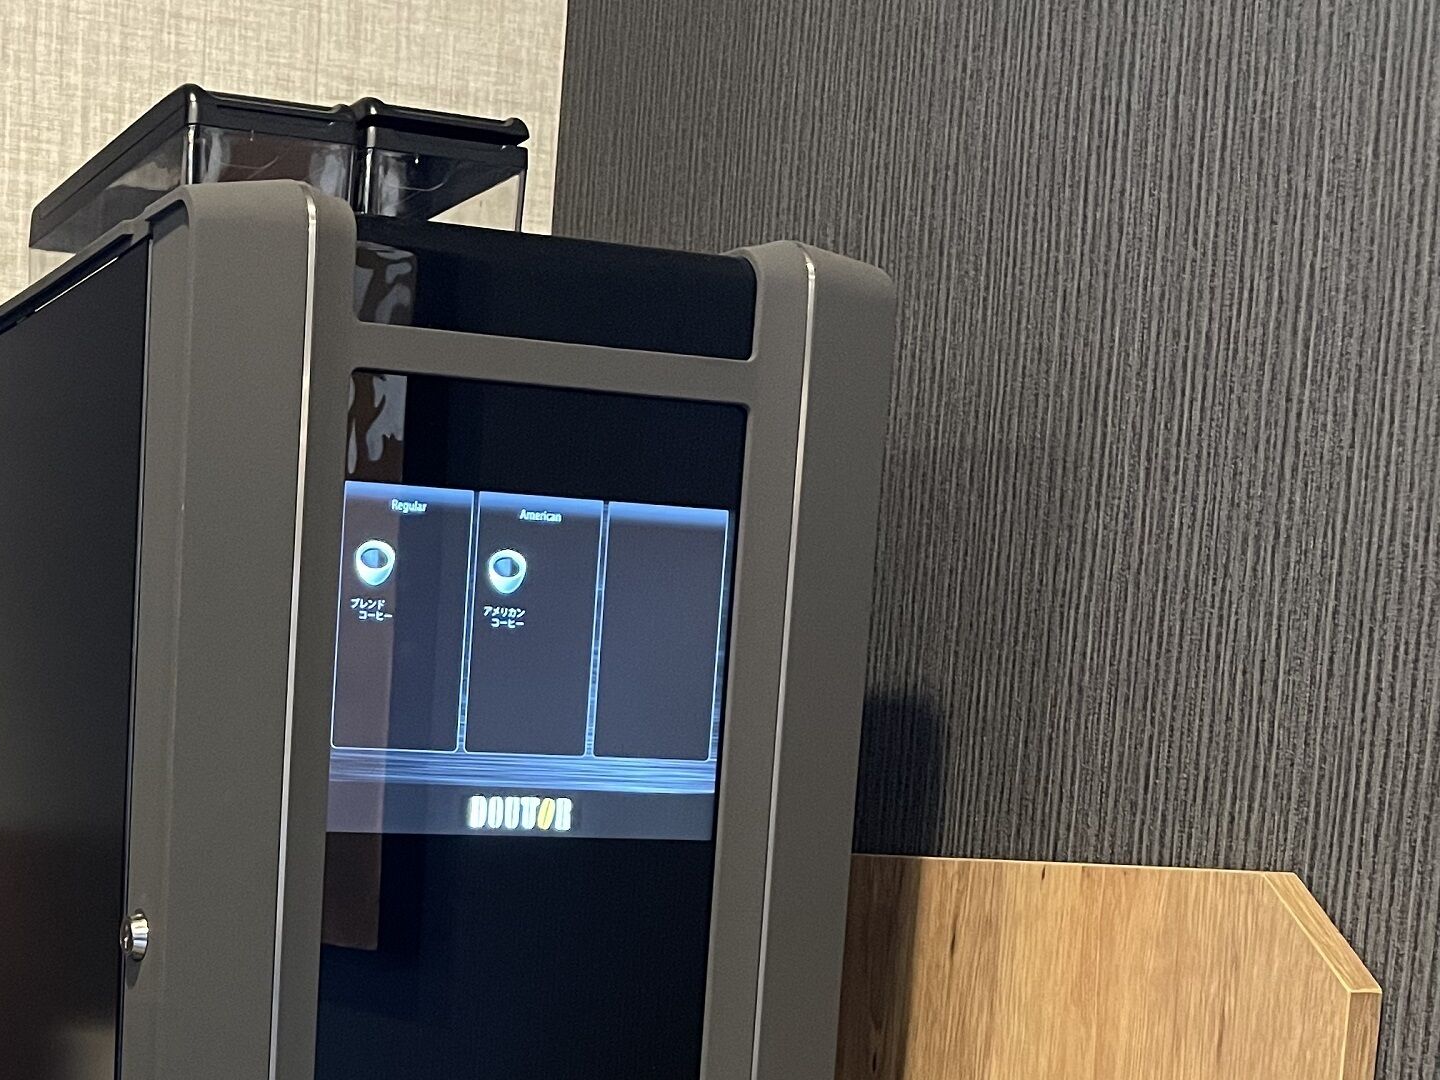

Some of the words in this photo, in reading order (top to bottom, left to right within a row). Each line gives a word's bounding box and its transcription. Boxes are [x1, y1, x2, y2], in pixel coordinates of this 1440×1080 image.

[391, 499, 428, 514] Regular
[519, 509, 563, 523] American
[358, 610, 393, 621] コーヒー
[483, 606, 526, 618] アメリカン
[490, 618, 525, 629] コーヒー
